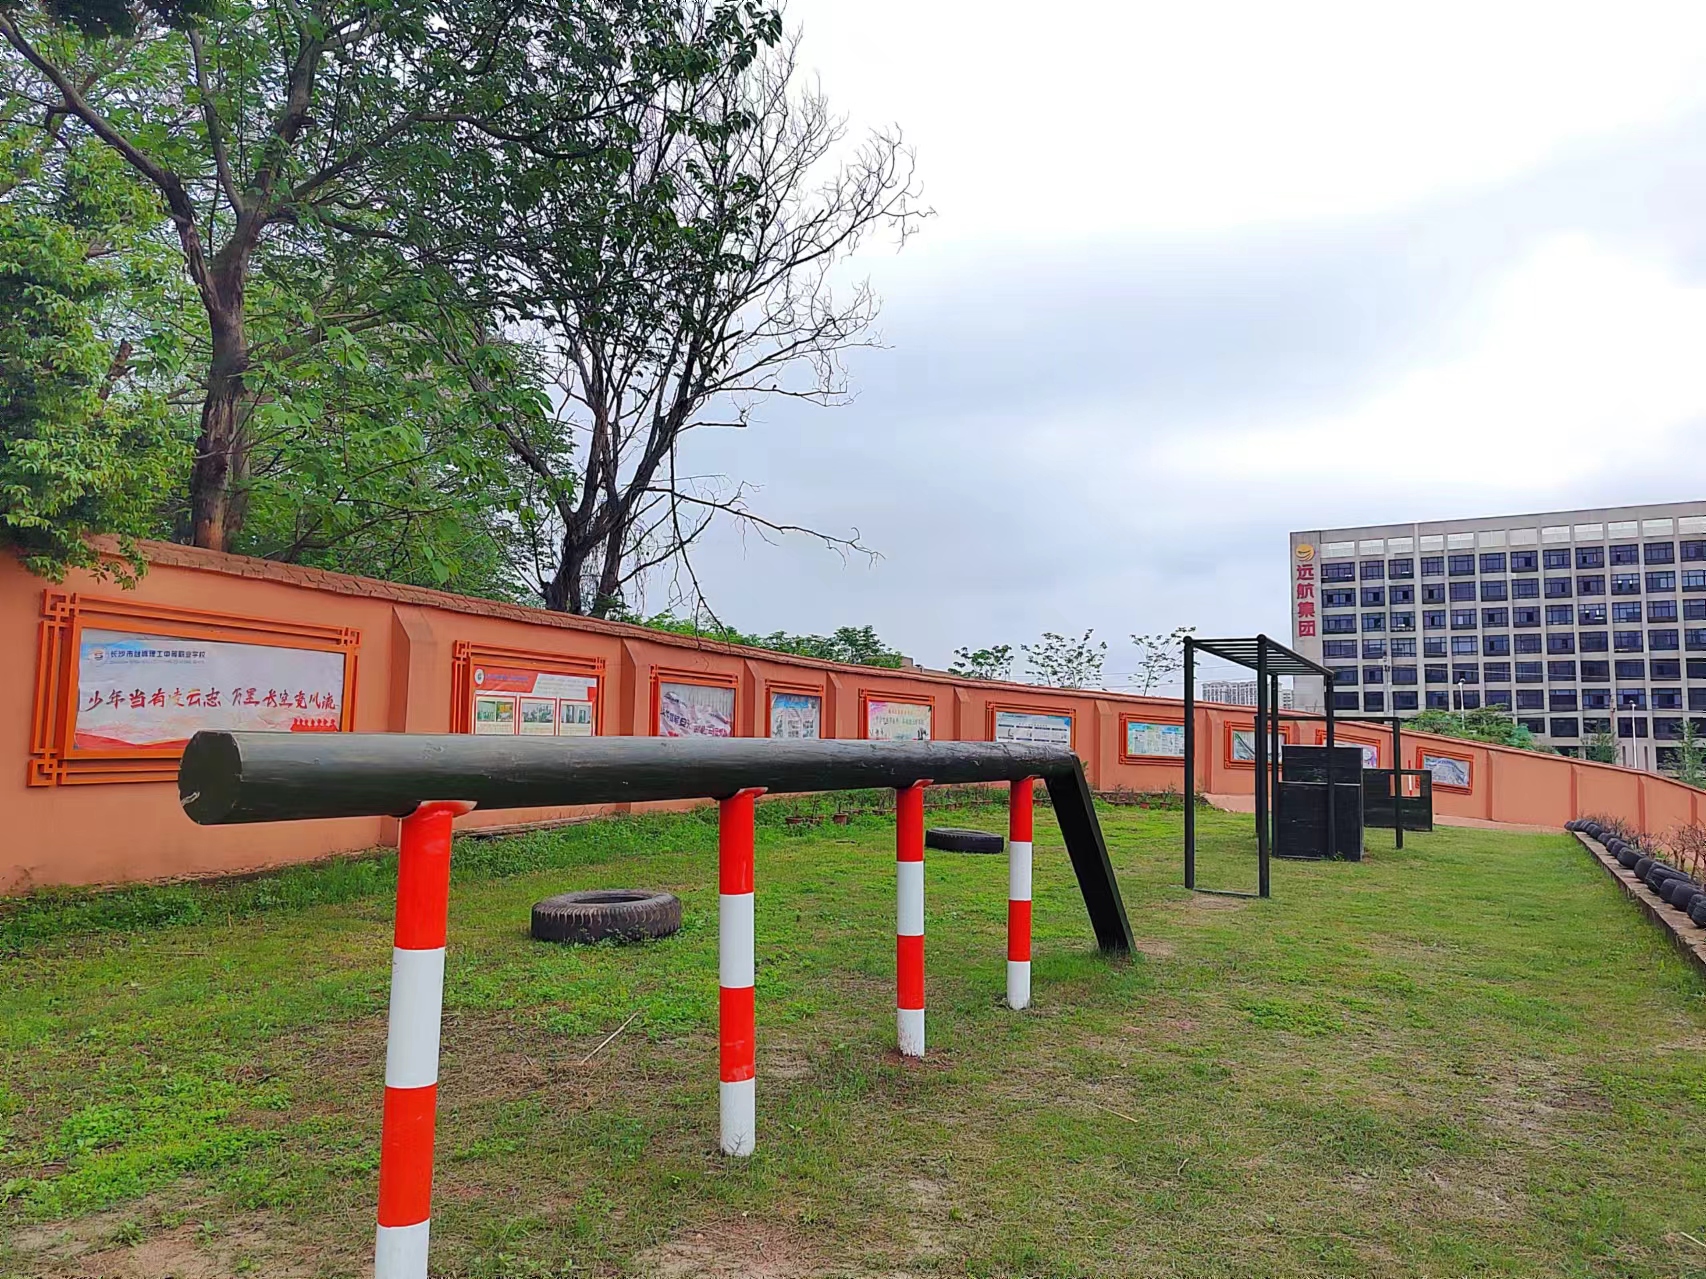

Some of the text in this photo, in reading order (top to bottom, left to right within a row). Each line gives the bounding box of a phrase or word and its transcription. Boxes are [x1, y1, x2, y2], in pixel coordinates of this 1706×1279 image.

[1296, 564, 1316, 637] 远航集团
[83, 688, 222, 712] 少年当有凌云志
